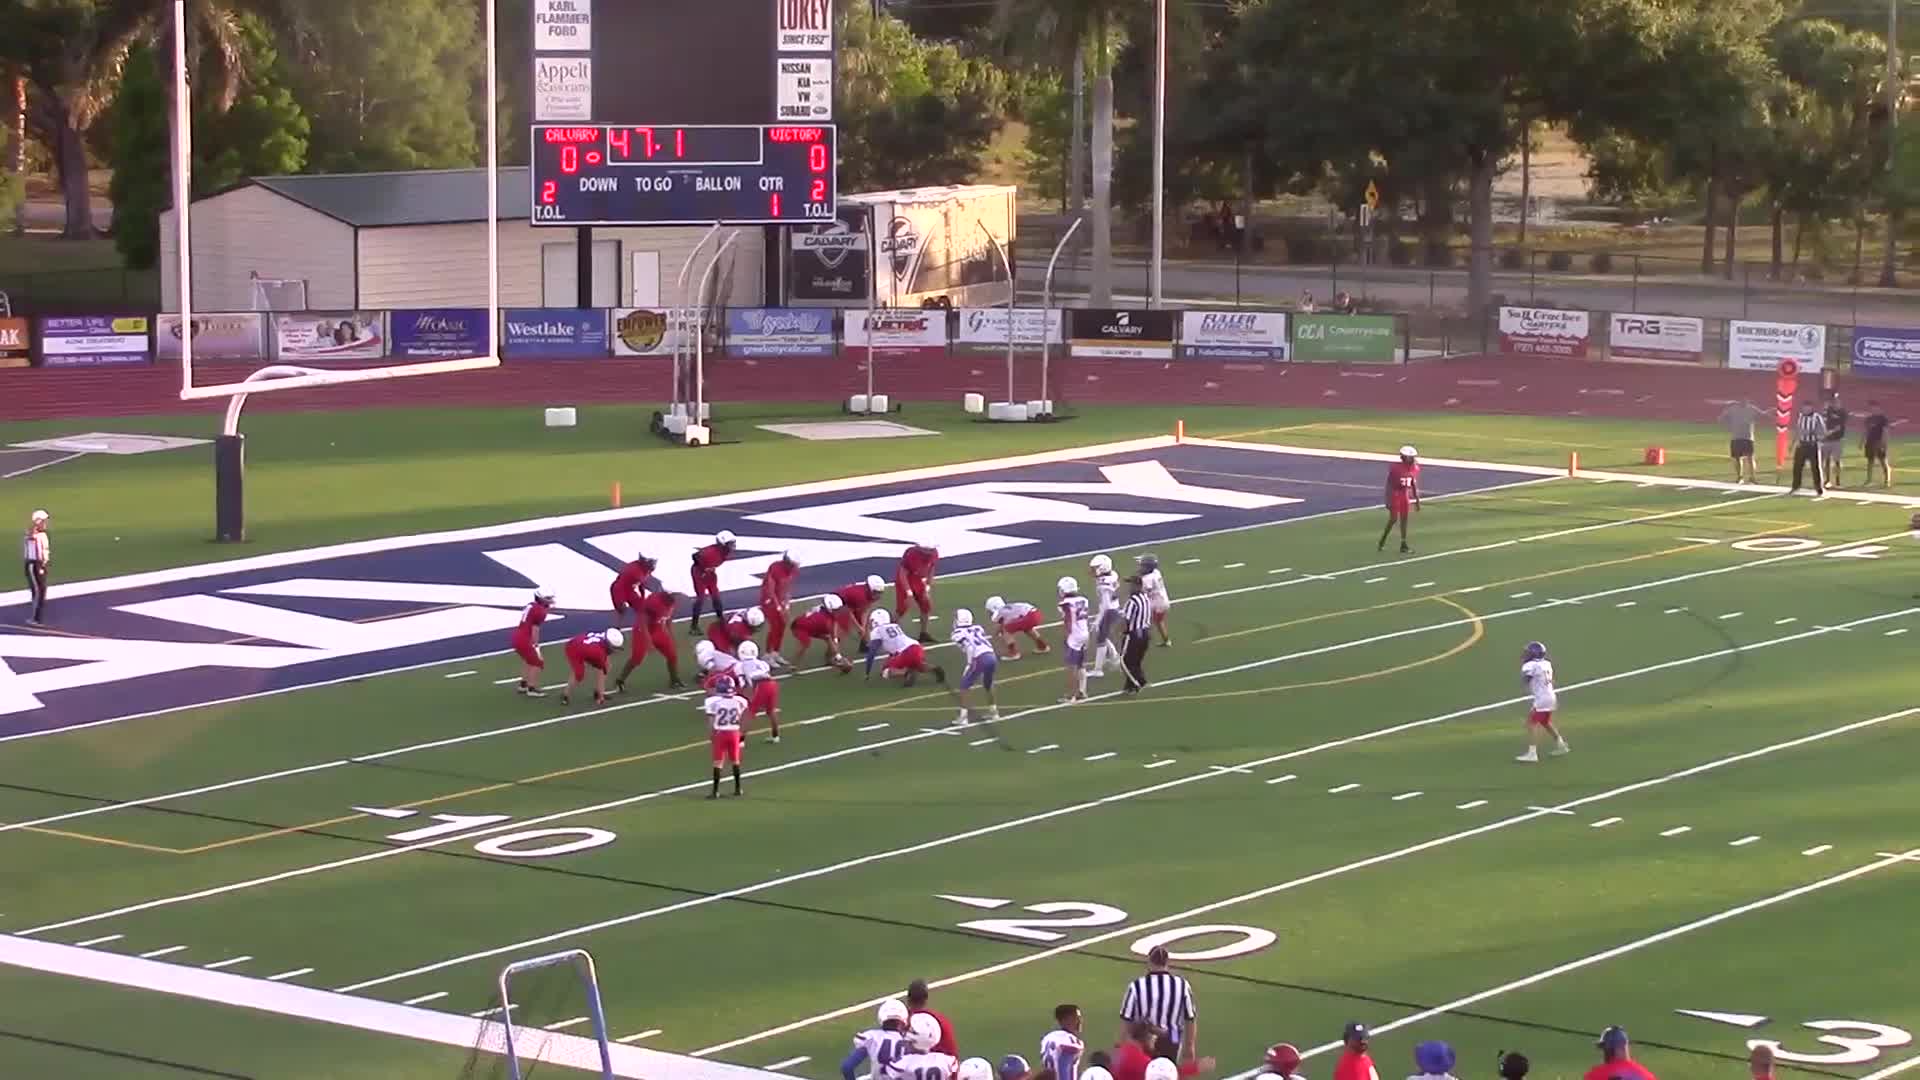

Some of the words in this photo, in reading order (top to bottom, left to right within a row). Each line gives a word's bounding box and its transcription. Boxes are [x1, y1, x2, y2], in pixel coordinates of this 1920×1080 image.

[548, 0, 577, 12] KARL
[536, 13, 590, 24] FLAMMER
[548, 25, 577, 37] FORD
[537, 62, 589, 83] Appelt
[781, 62, 811, 74] NISSAN
[797, 77, 811, 88] KIA
[780, 105, 811, 117] SUBARU
[545, 128, 599, 142] CALVARY
[770, 128, 822, 142] VICTORY
[561, 146, 577, 172] 0
[810, 144, 826, 171] 0
[579, 177, 618, 192] DOWN
[635, 177, 652, 192] TO
[653, 177, 672, 192] GO
[695, 176, 723, 191] BALL
[724, 176, 741, 191] ON
[759, 176, 784, 191] QTR
[811, 179, 826, 200] 2
[543, 181, 556, 203] 2
[803, 236, 858, 247] CALVARY
[880, 236, 919, 254] CALVARY
[507, 321, 575, 337] Westlake
[1101, 324, 1143, 335] CALVARY
[1297, 324, 1325, 340] CCA
[1615, 318, 1661, 335] TRG
[717, 708, 739, 727] 22
[386, 814, 617, 858] 10
[956, 901, 1277, 960] 20
